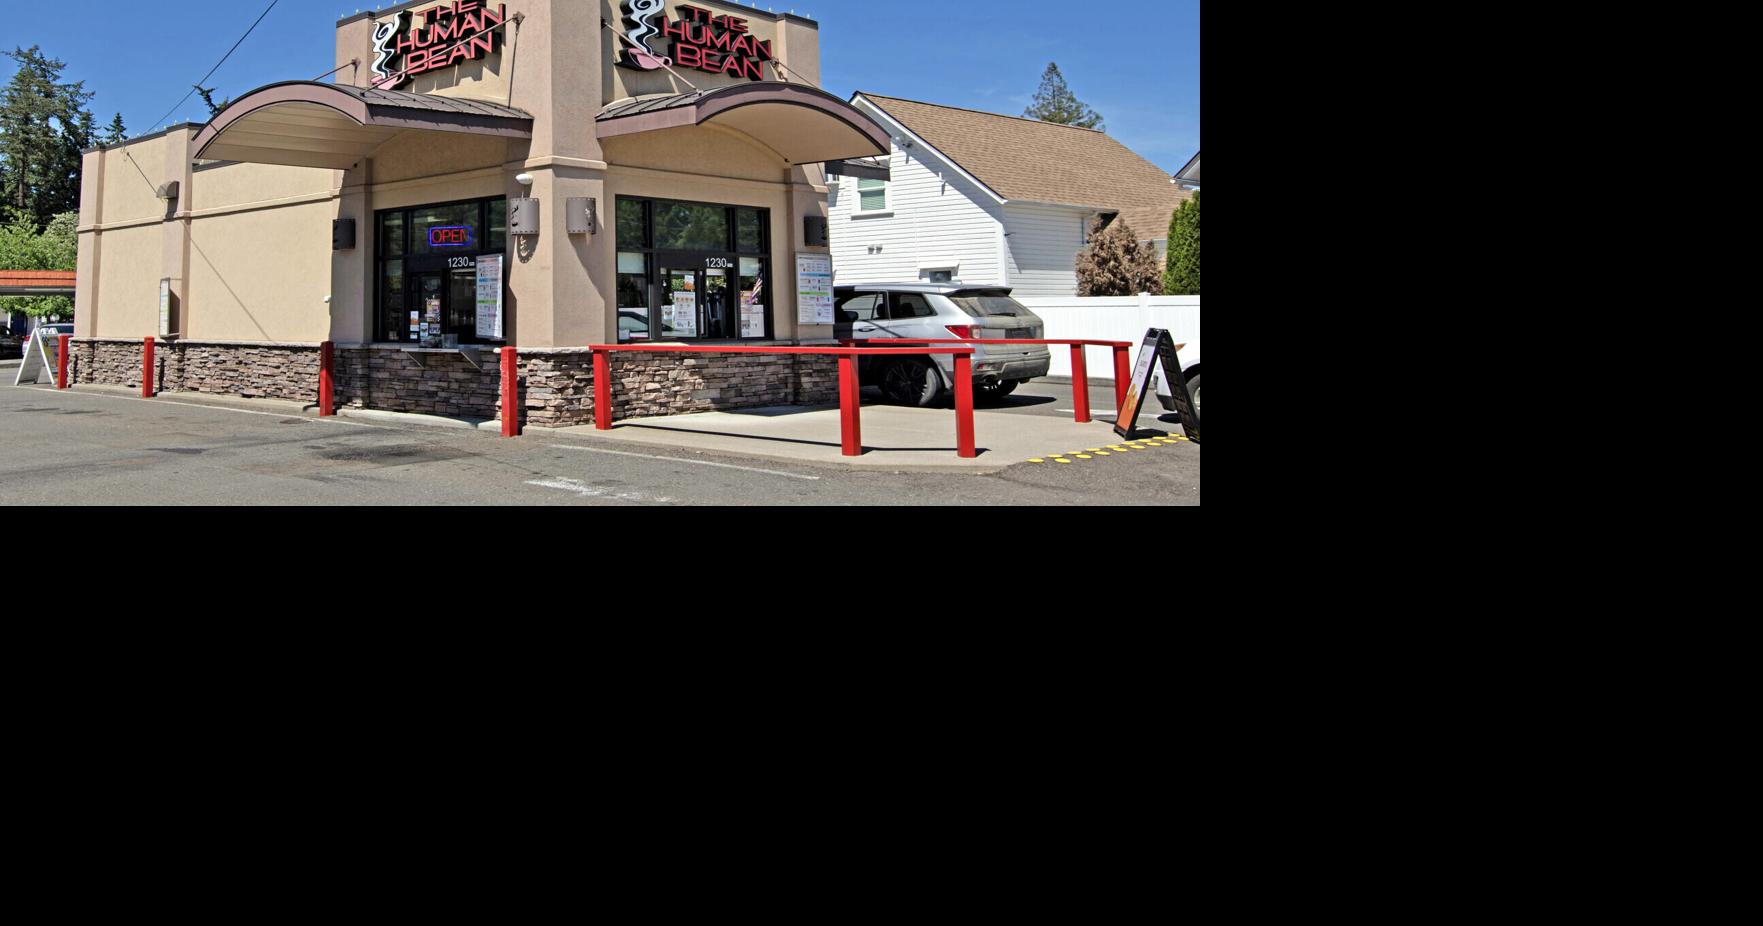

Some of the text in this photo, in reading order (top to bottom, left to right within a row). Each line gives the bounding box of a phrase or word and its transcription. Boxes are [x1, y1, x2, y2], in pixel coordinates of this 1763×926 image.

[415, 0, 478, 24] THE
[682, 4, 749, 34] THE
[396, 4, 504, 54] HUMAN
[663, 15, 772, 60] HUMAN
[407, 32, 493, 75] BEAN
[677, 43, 764, 80] BEAN
[432, 229, 469, 243] OPEN
[447, 256, 469, 268] 1230
[705, 257, 727, 268] 1230
